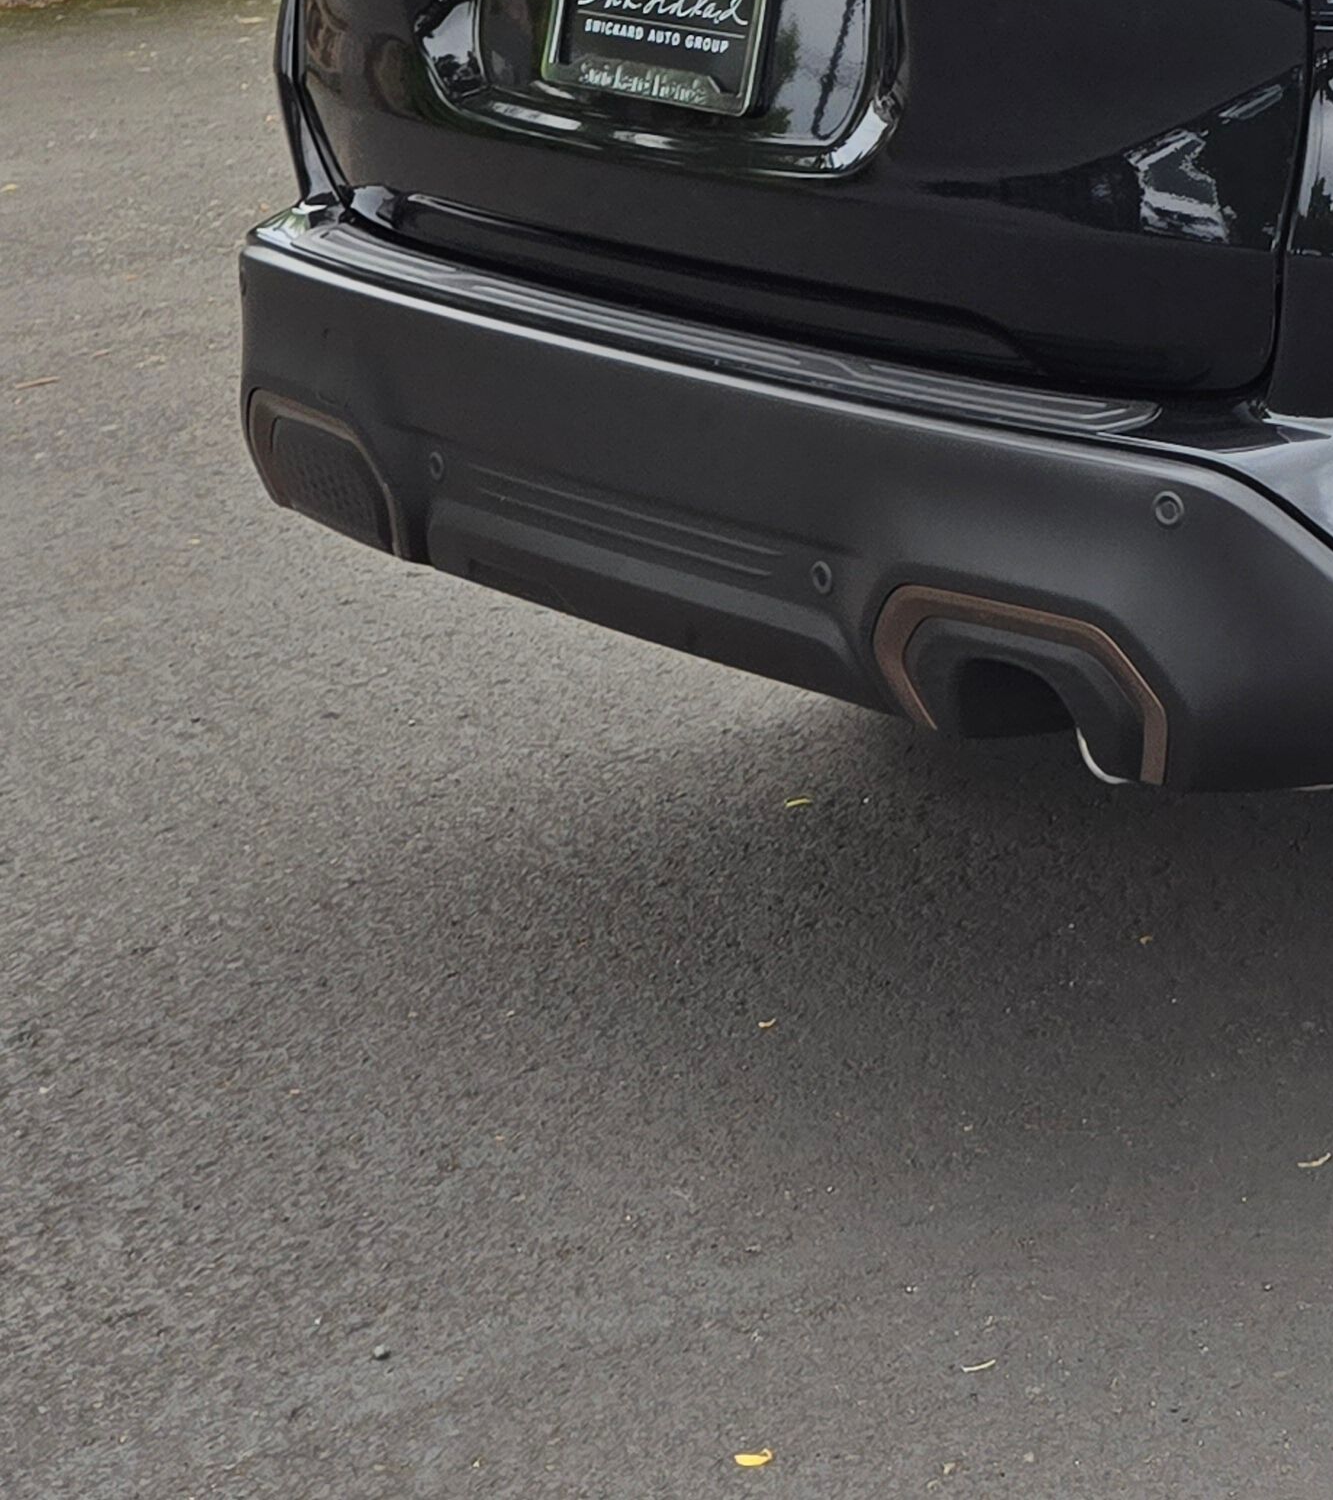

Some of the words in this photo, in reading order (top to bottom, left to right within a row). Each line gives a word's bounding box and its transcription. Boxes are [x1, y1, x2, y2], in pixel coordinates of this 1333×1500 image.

[584, 18, 644, 40] SWICKARD
[647, 28, 681, 46] AUTO
[684, 34, 730, 54] GROUP
